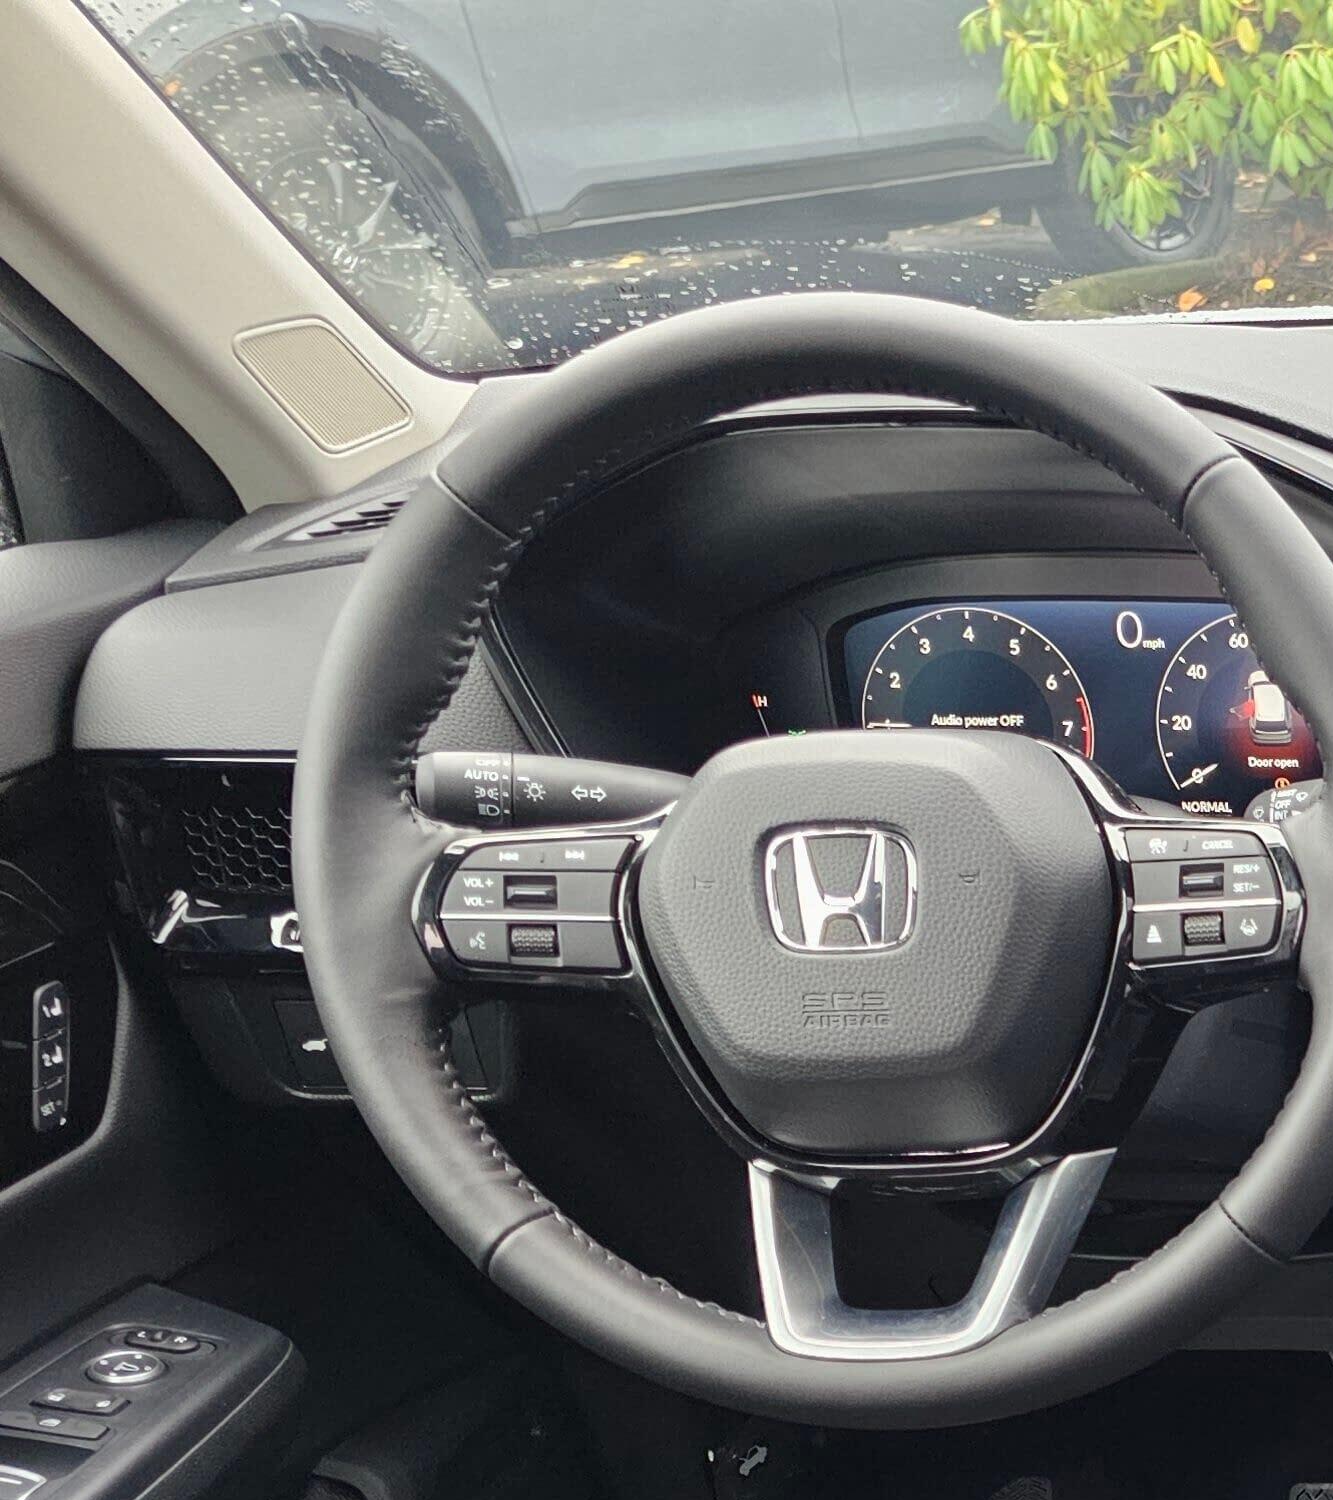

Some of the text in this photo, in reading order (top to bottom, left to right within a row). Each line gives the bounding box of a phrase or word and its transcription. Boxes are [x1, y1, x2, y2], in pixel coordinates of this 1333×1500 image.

[963, 626, 974, 642] 4
[1116, 611, 1165, 651] 0 mph
[919, 638, 931, 654] 3
[1009, 638, 1020, 655] 5
[1228, 633, 1248, 648] 60
[1186, 664, 1207, 680] 40
[889, 672, 901, 689] 2
[1045, 674, 1058, 690] 6
[931, 713, 1024, 730] Audio power OFF
[1062, 720, 1074, 737] 7
[1171, 715, 1192, 731] 20
[1248, 756, 1299, 770] Door open
[464, 769, 499, 780] AUTO
[1182, 801, 1233, 813] NORMAL
[1275, 800, 1291, 809] OFF
